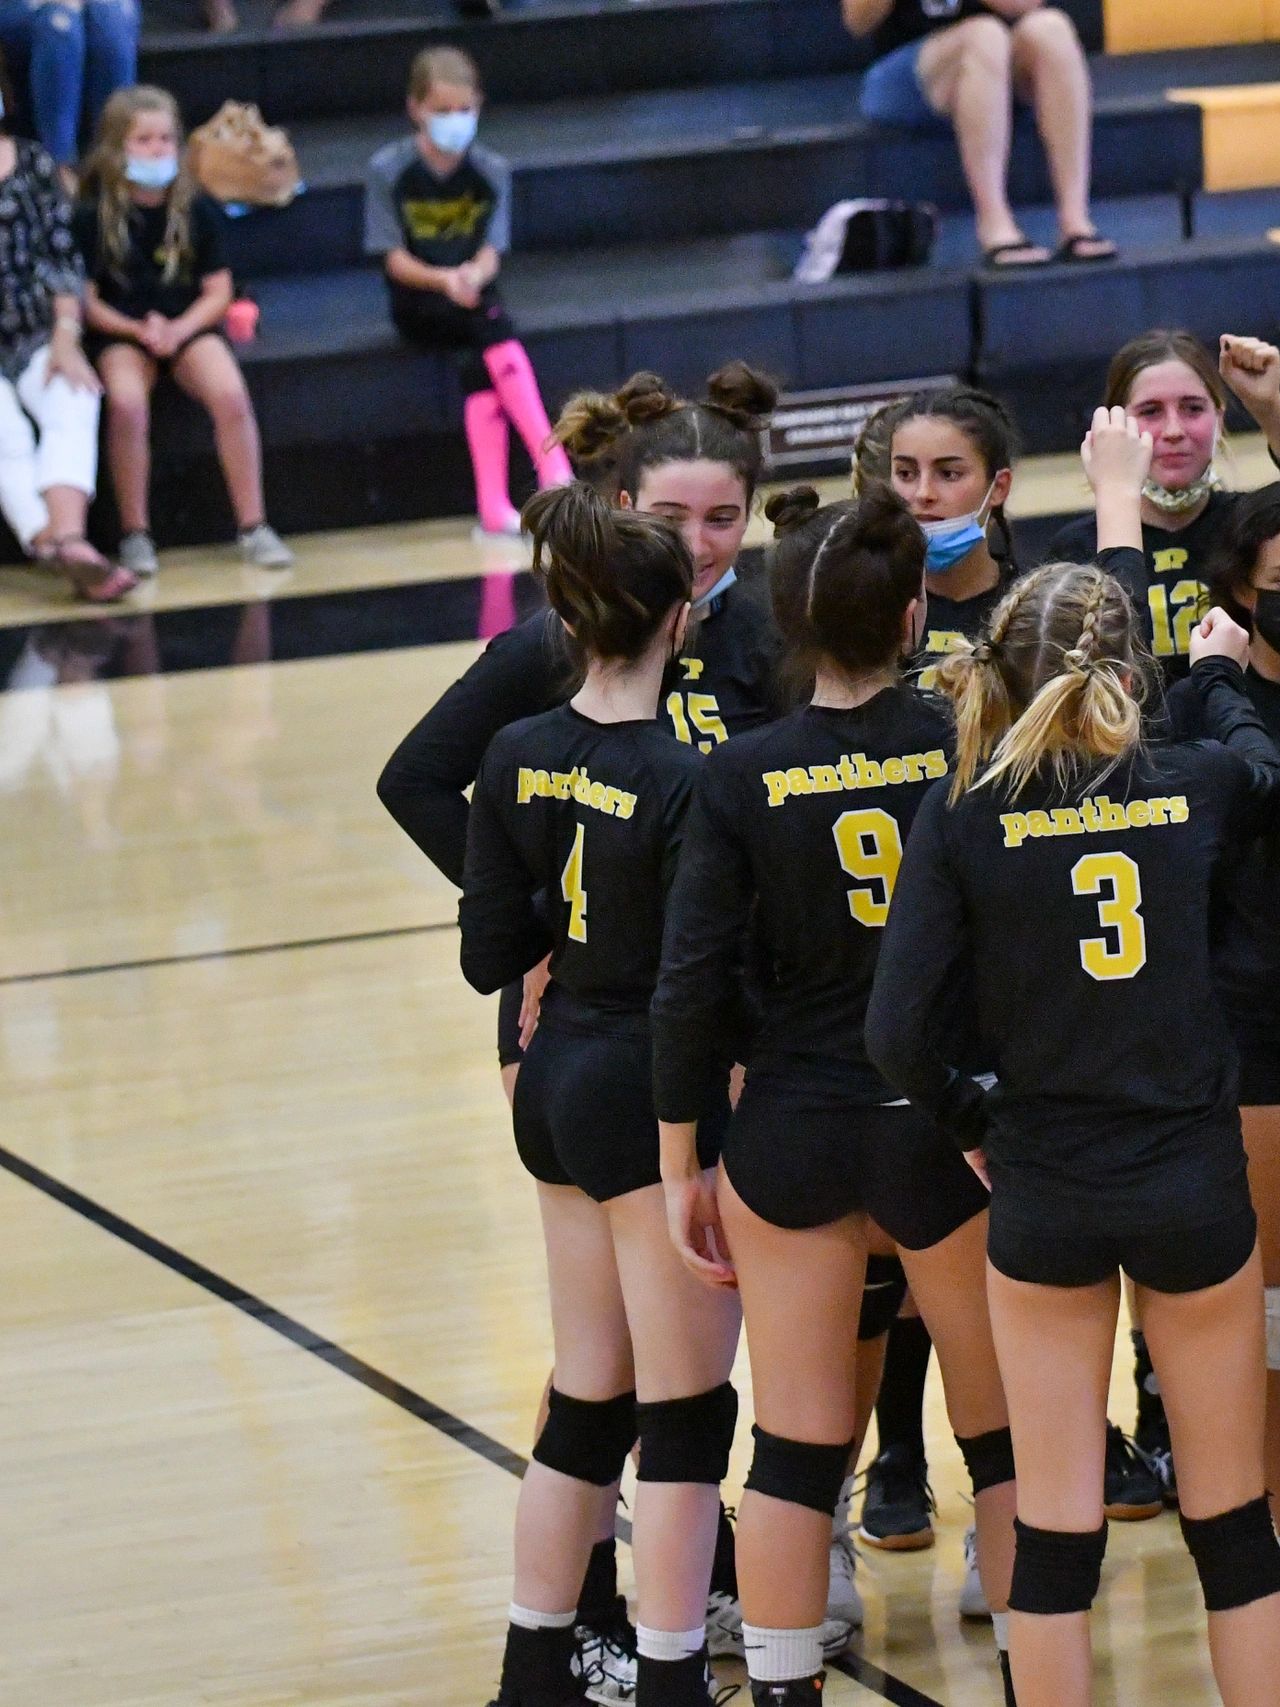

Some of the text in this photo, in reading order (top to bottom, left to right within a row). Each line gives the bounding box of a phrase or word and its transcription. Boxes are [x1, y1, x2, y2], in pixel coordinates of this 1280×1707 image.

[1147, 579, 1210, 656] 12
[666, 691, 730, 755] 15
[516, 765, 638, 820] panthers
[761, 748, 949, 808] panthers
[999, 795, 1190, 848] panthers
[560, 822, 588, 944] 4
[831, 807, 903, 928] 9
[1070, 850, 1147, 981] 3
